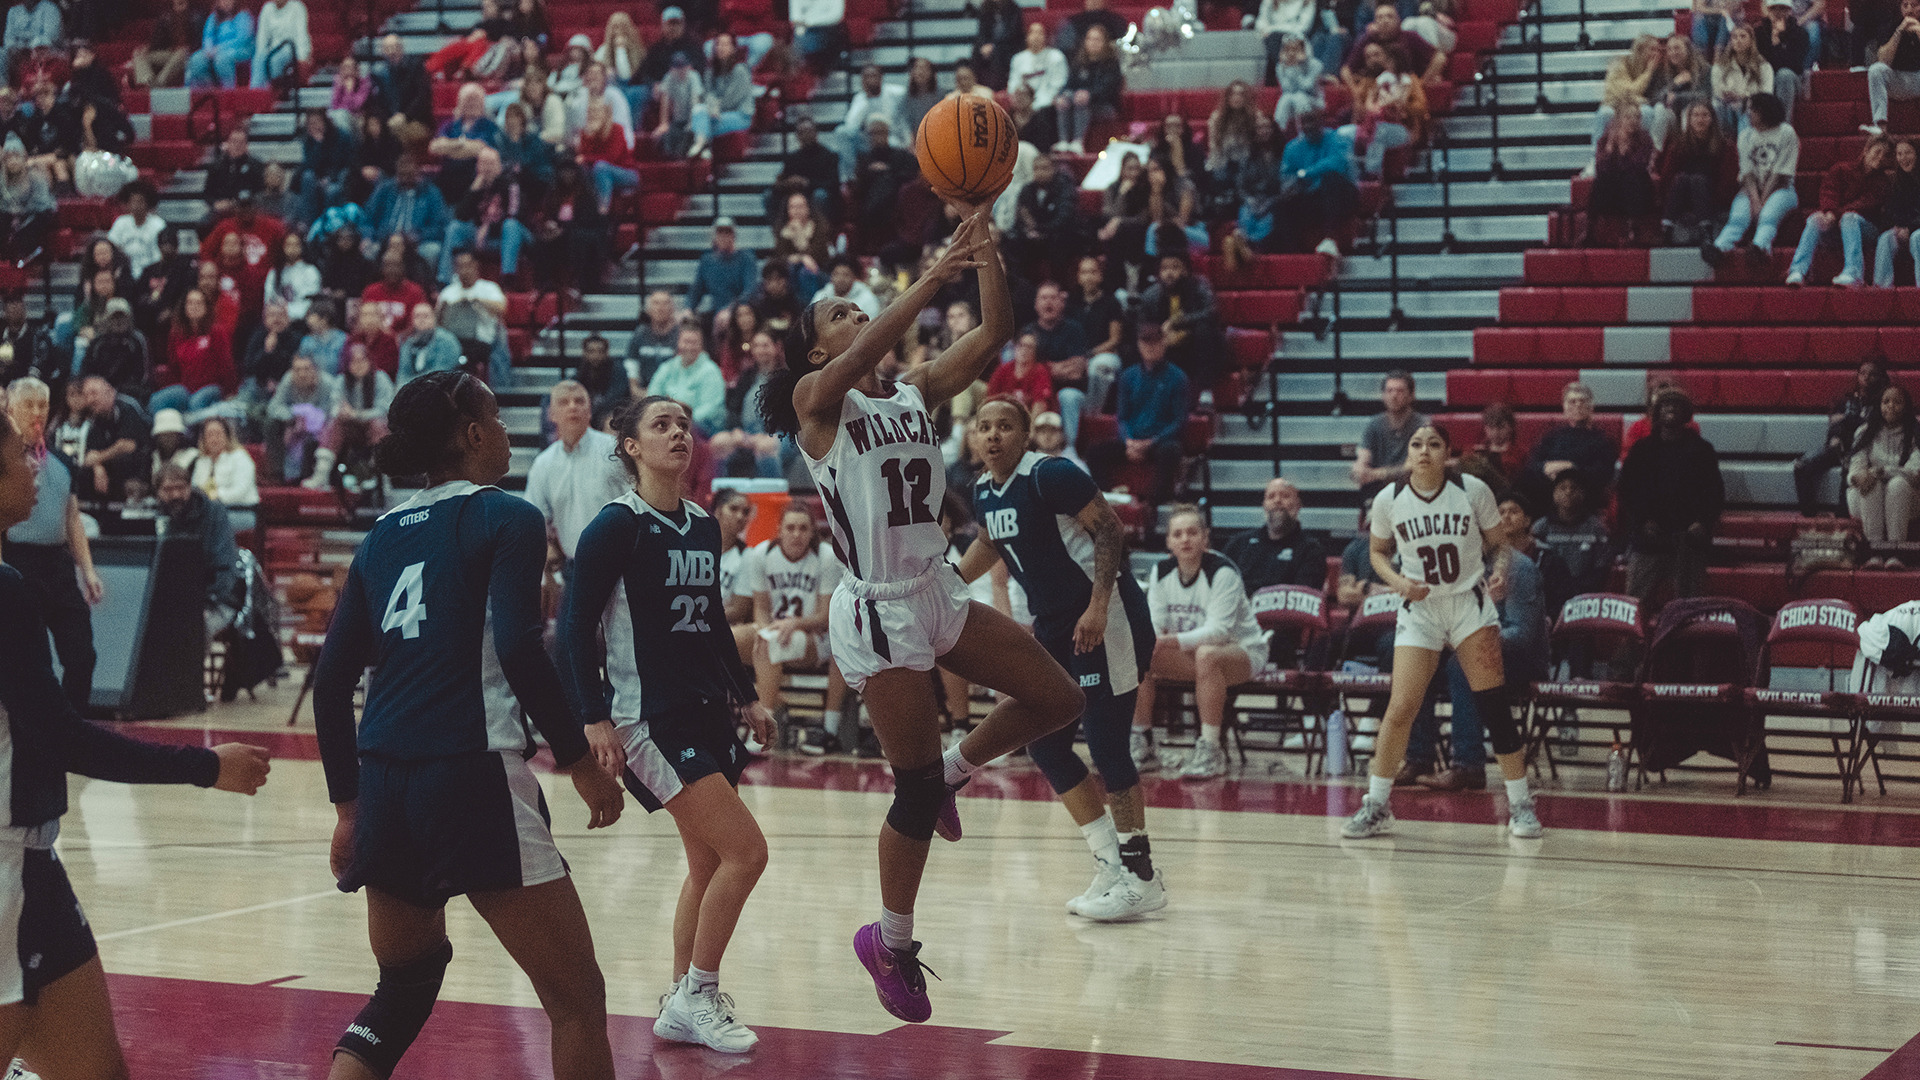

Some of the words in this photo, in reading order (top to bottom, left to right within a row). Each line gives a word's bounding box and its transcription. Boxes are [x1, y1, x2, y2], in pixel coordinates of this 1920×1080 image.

[973, 103, 989, 148] NCAA
[881, 458, 937, 529] 12
[399, 509, 430, 527] OTTERS
[985, 508, 1019, 541] MB
[1396, 513, 1471, 544] WILDCATS
[665, 549, 715, 587] MB
[1417, 543, 1460, 586] 20
[381, 561, 427, 640] 4
[670, 595, 711, 632] 23
[1252, 591, 1286, 613] CHICO
[1287, 591, 1322, 617] STATE
[1564, 599, 1600, 623] CHICO
[1601, 599, 1638, 626] STATE
[1780, 605, 1818, 630] CHICO
[1818, 605, 1857, 633] STATE
[1079, 673, 1101, 687] MB
[1538, 683, 1600, 694] WILDCATS
[1654, 685, 1719, 696] WILDCATS
[1755, 691, 1822, 704] WILDCATS
[345, 1022, 382, 1046] ueller
